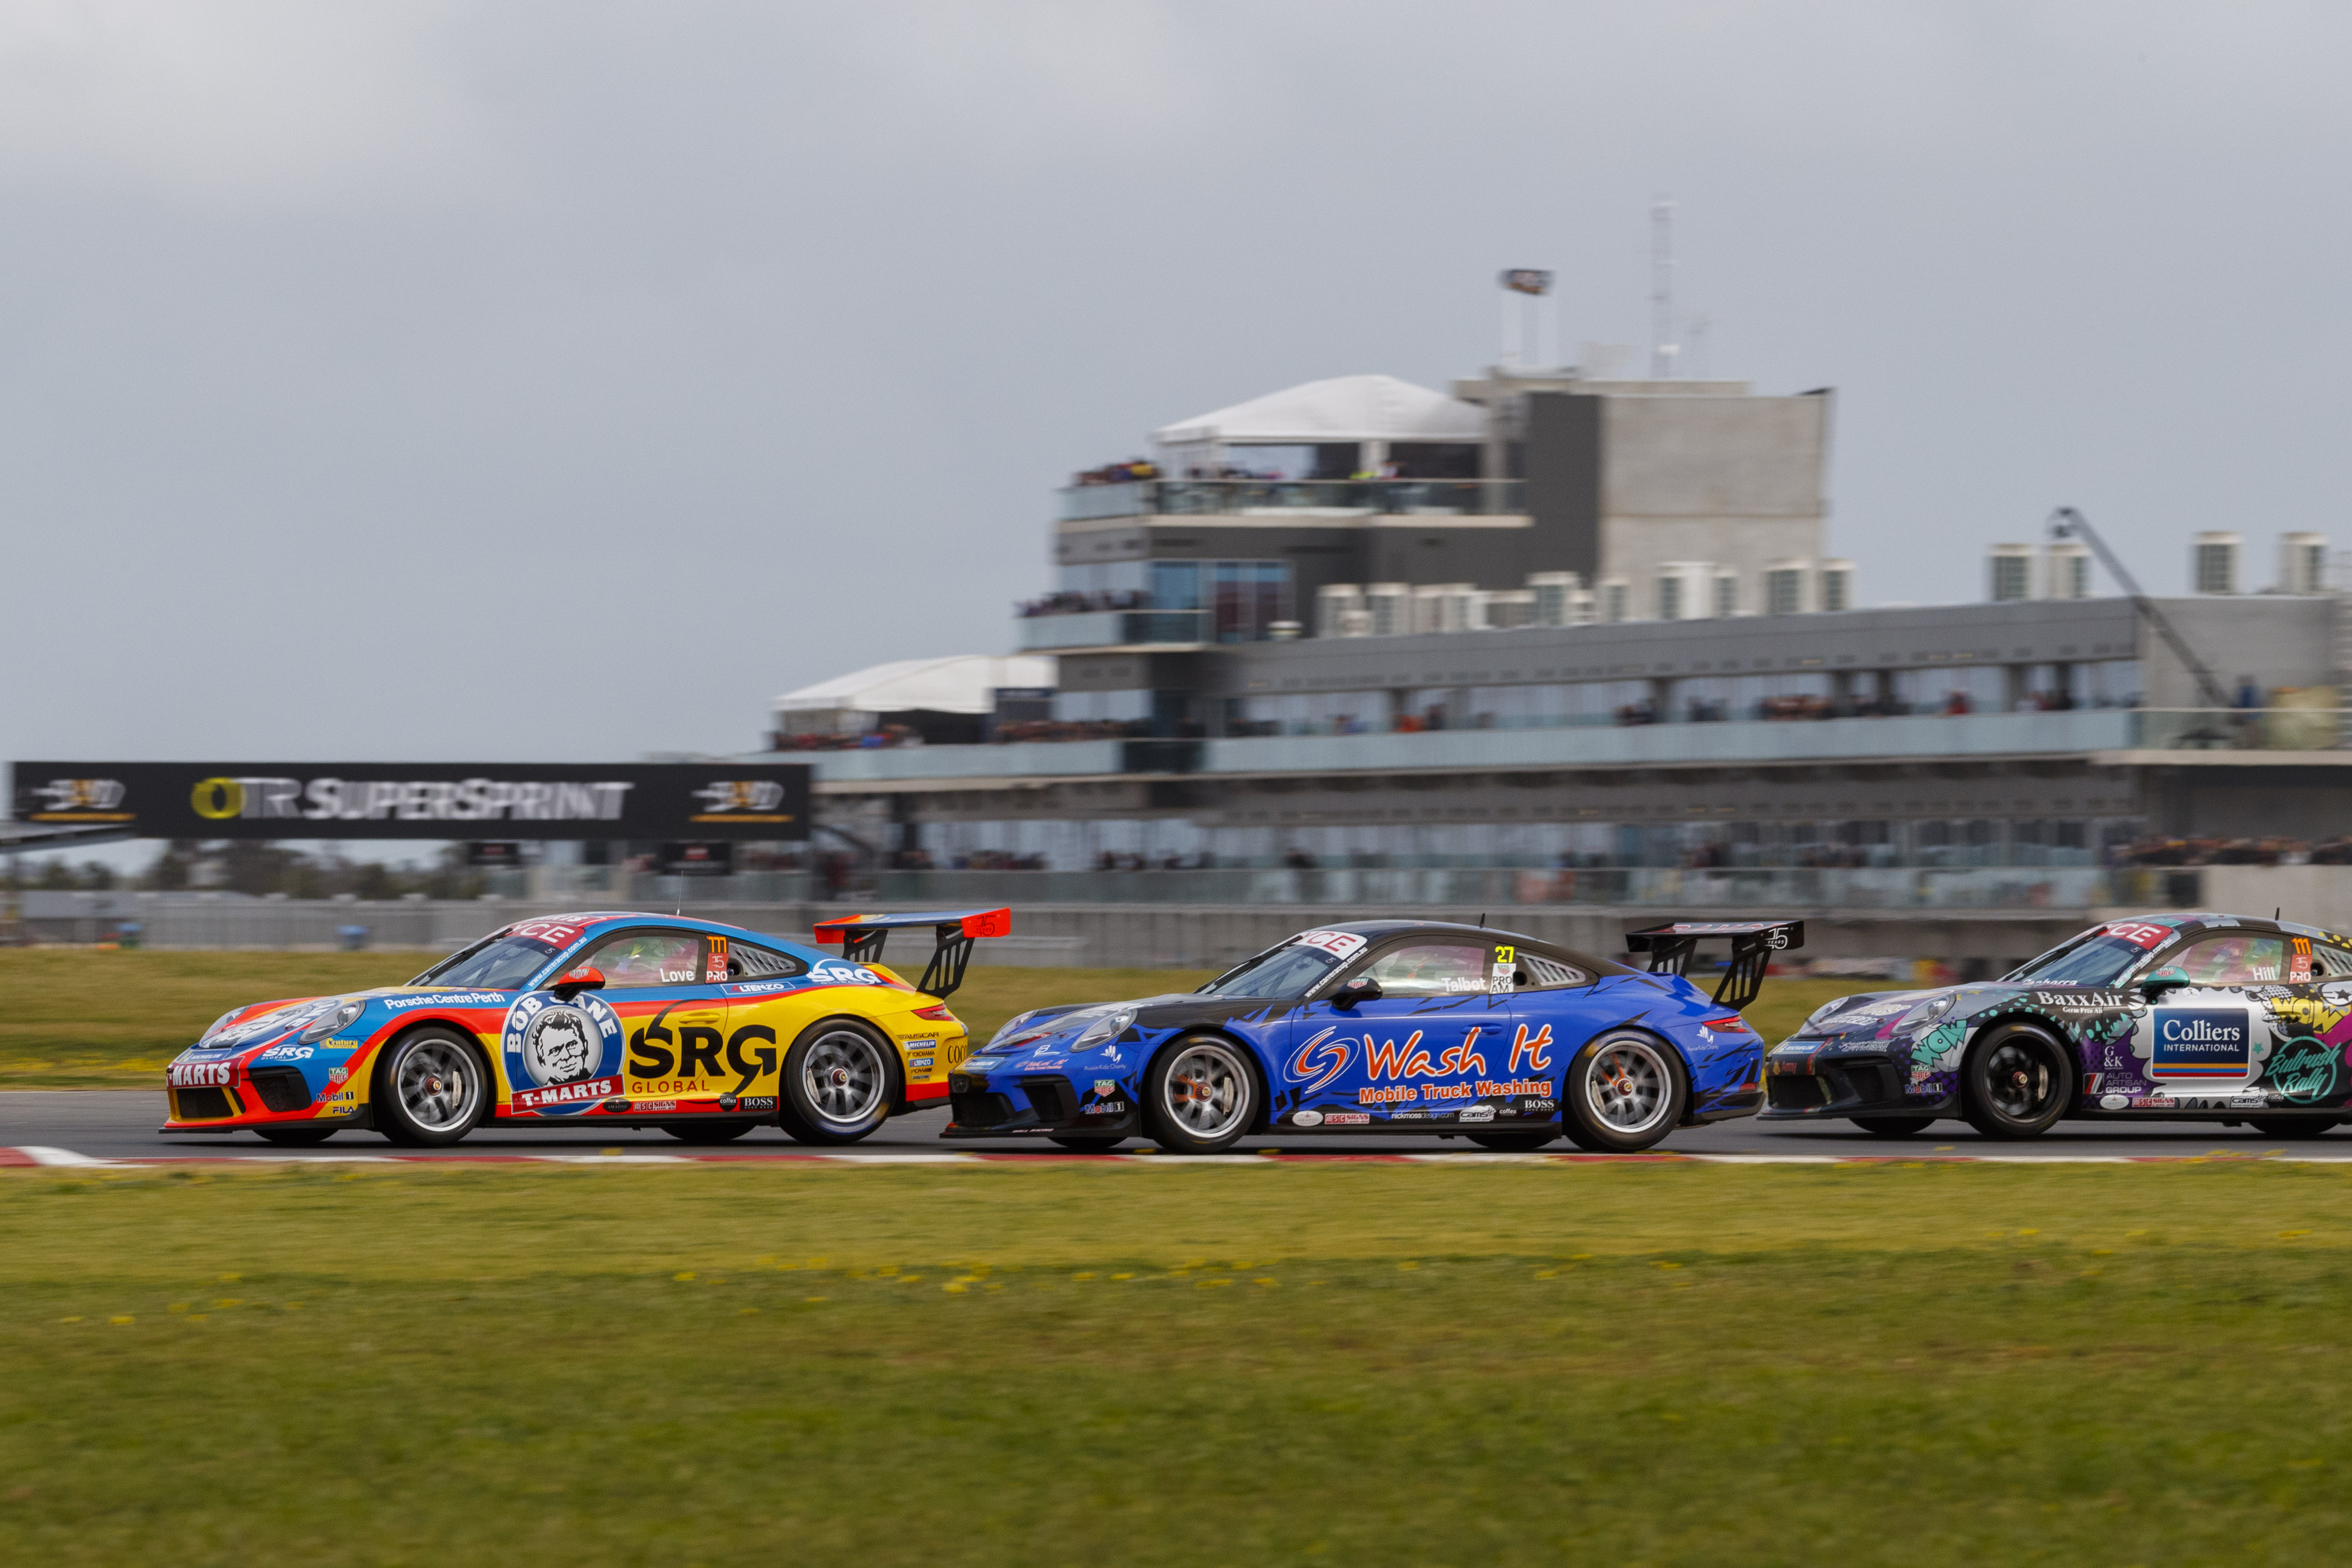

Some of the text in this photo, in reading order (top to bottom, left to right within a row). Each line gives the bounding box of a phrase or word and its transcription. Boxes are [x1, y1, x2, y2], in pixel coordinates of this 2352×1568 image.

[1766, 927, 1789, 949] 15
[1495, 946, 1515, 963] 27
[527, 937, 587, 988] www.carreracup.com.au
[660, 968, 695, 982] Love
[707, 971, 727, 981] PRO
[806, 965, 882, 985] SRG
[1492, 976, 1512, 984] PRO
[2252, 967, 2276, 981] Hill
[2290, 971, 2311, 981] PRO
[731, 984, 784, 992] ALTENZO
[1442, 977, 1487, 992] Talbot
[1491, 985, 1509, 993] AM
[385, 992, 505, 1009] Porsche Centre Perth
[2035, 991, 2123, 1007] BaxxAir
[507, 996, 543, 1054] BOB
[2163, 1019, 2241, 1042] Colliers
[262, 1046, 314, 1059] SRG
[629, 1024, 777, 1079] SRG
[1363, 1023, 1554, 1081] Wash It
[2104, 1046, 2115, 1057] G
[2163, 1044, 2240, 1052] INTERNATIONAL
[2104, 1056, 2123, 1067] &K
[329, 1074, 348, 1083] HEUER
[2281, 1067, 2328, 1101] Rally
[521, 1079, 612, 1104] T-MARTS
[632, 1079, 710, 1094] GLOBAL
[1359, 1078, 1552, 1105] Mobile Truck Washing
[1905, 1083, 1941, 1094] Mobil 1
[316, 1092, 353, 1103] Mobil 1
[744, 1097, 773, 1106] BOSS
[1525, 1099, 1555, 1109] BOSS
[333, 1106, 355, 1114] FILA
[1085, 1102, 1122, 1115] Mobil 1
